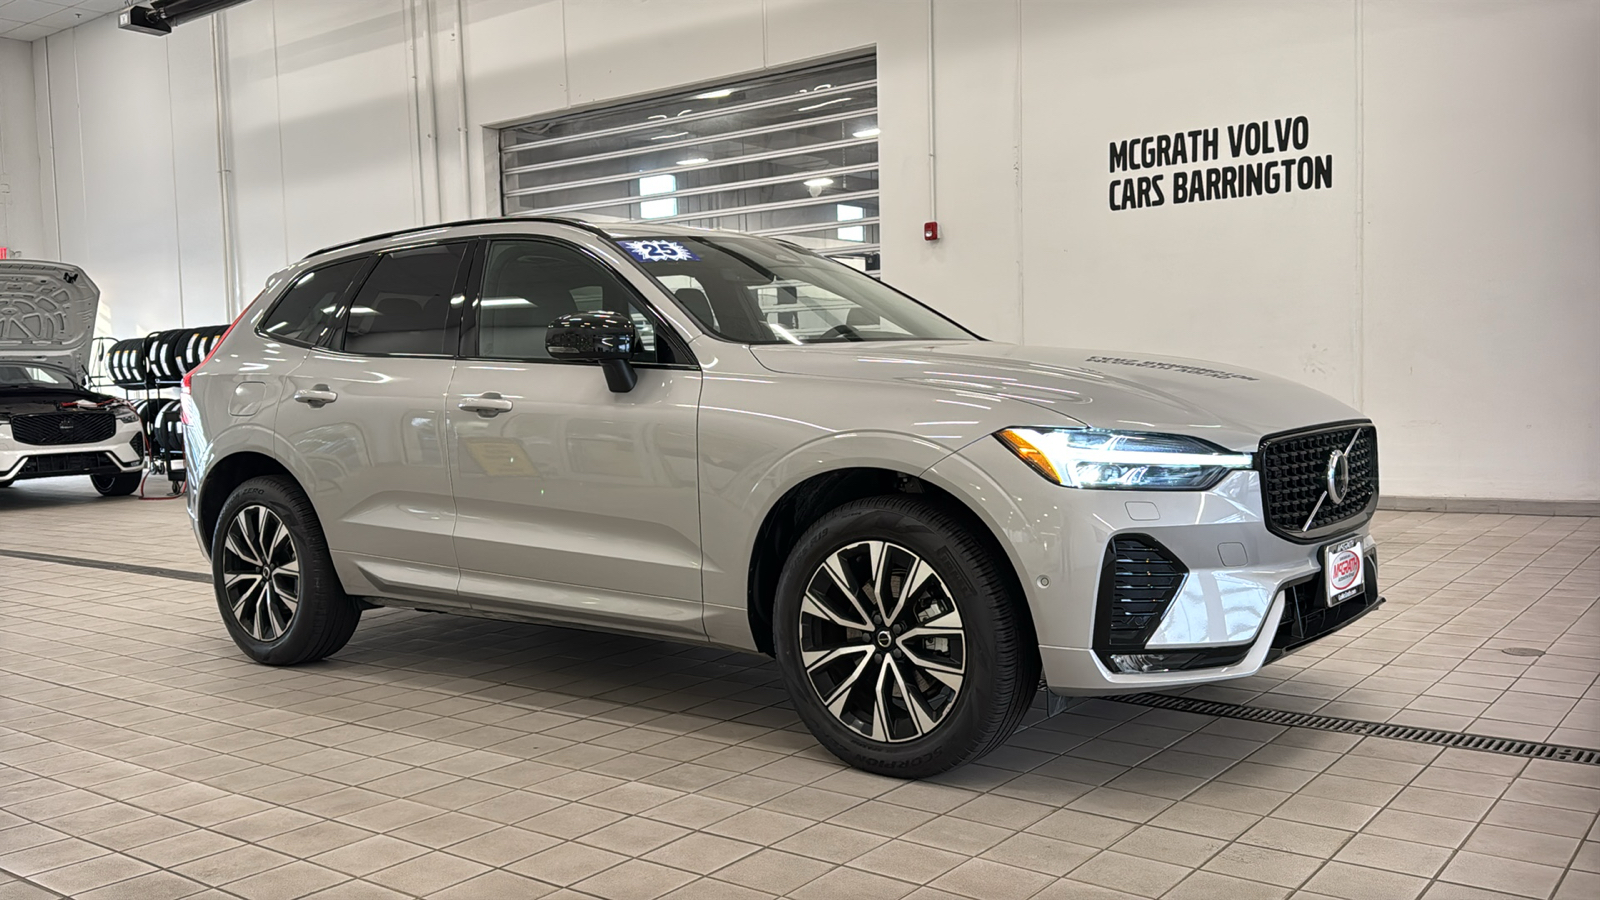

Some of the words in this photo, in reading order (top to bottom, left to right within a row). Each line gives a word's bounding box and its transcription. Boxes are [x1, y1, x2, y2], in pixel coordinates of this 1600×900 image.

[1109, 127, 1219, 173] MCGRATH
[1227, 115, 1309, 158] VOLVO
[1109, 174, 1165, 211] CARS
[1173, 154, 1333, 204] BARRINGTON
[642, 244, 678, 256] 25
[855, 745, 943, 769] SCORPION
